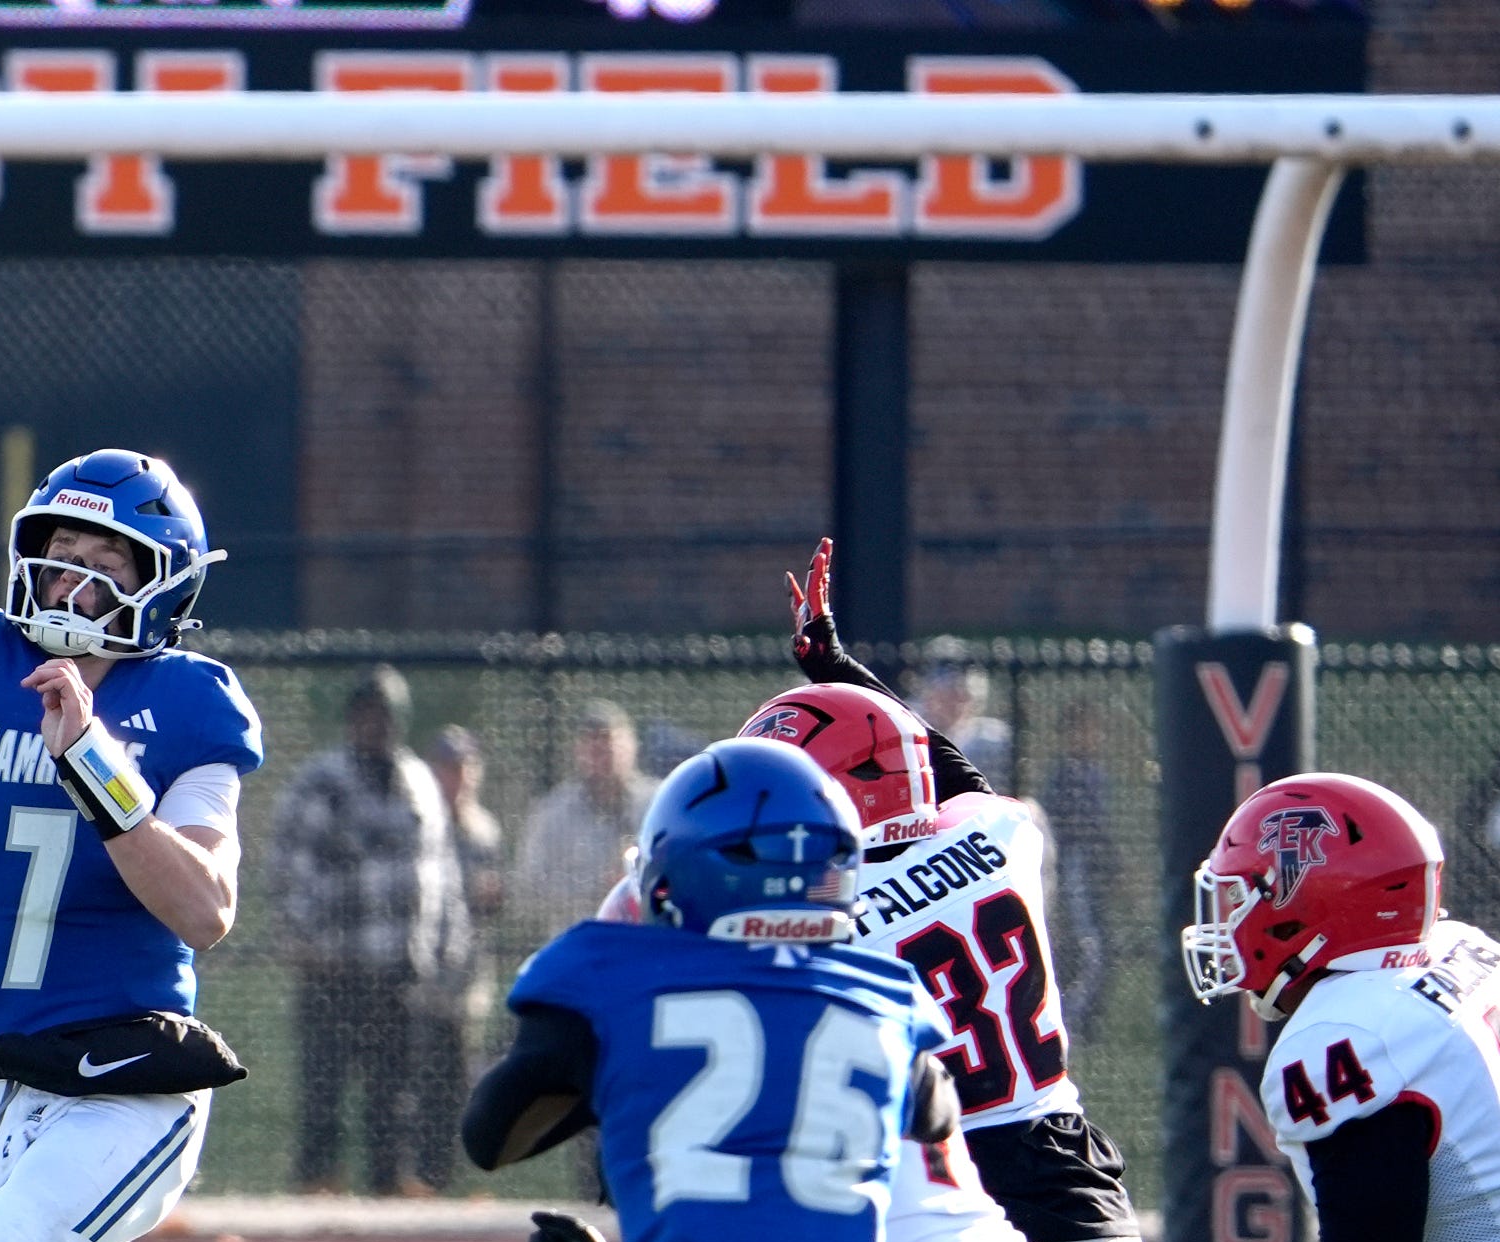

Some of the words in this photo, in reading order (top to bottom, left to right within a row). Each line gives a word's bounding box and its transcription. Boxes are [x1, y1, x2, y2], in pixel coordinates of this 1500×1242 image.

[312, 51, 1083, 237] FIELD
[56, 493, 109, 513] Riddell
[1, 805, 78, 991] 7
[743, 917, 835, 939] Riddell
[853, 831, 1007, 938] FALCONS
[896, 887, 1069, 1117] 32
[647, 990, 897, 1216] 26
[1282, 1037, 1377, 1127] 44
